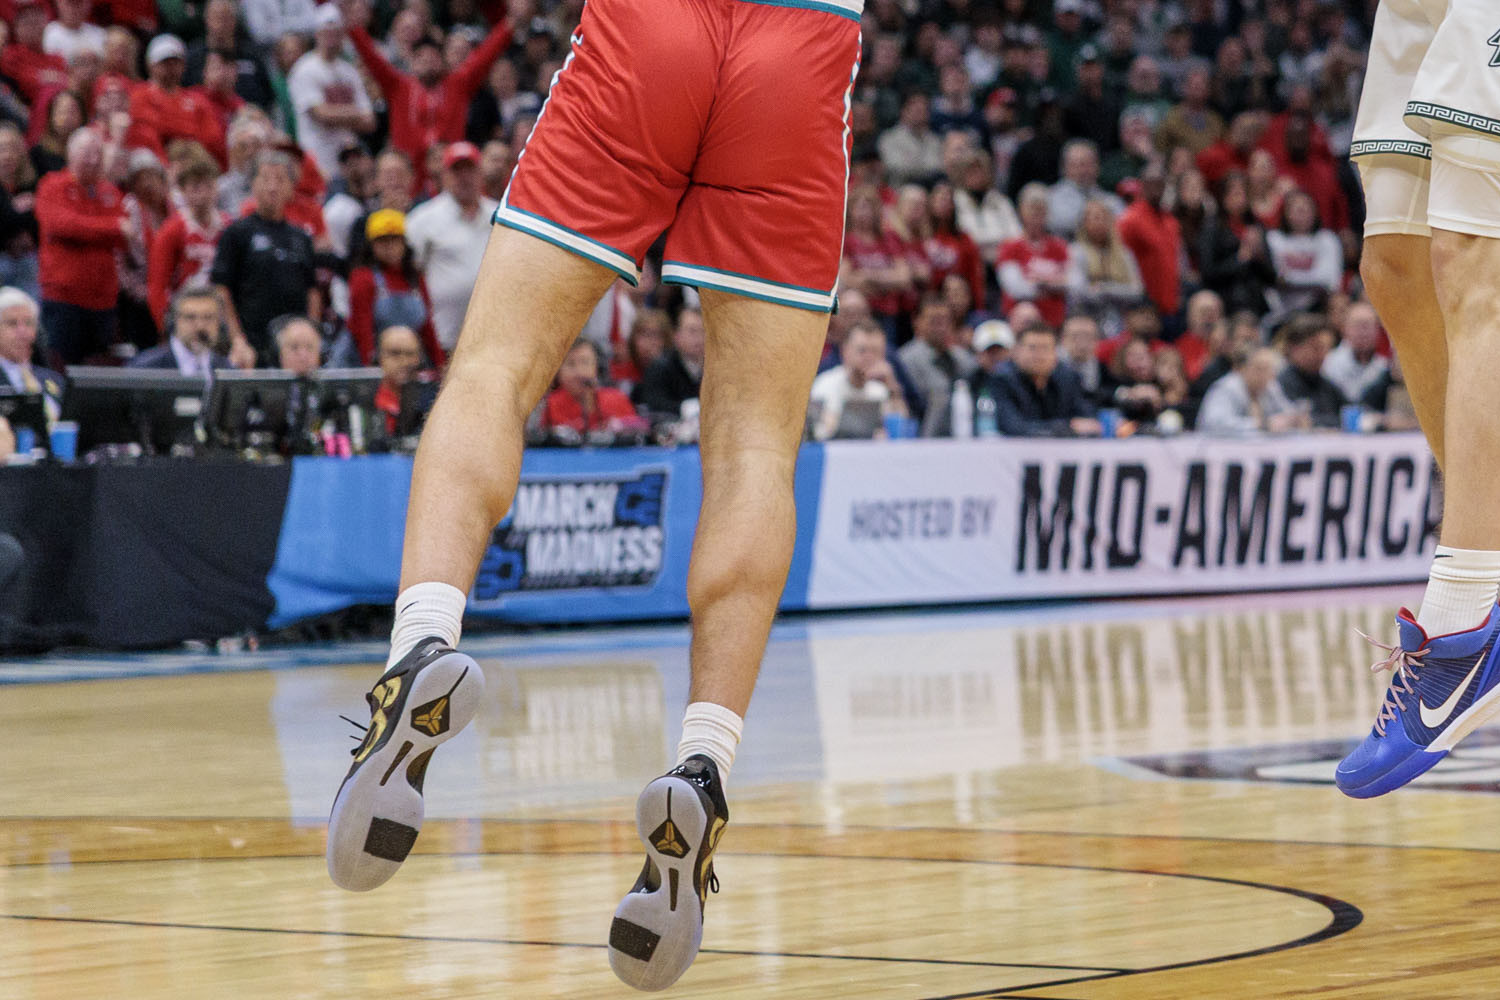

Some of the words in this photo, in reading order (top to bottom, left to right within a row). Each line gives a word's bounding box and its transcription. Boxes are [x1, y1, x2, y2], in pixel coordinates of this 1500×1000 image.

[514, 482, 620, 529] MARCH
[849, 499, 953, 540] HOSTED
[959, 497, 993, 538] BY
[1016, 455, 1443, 574] MID-AMERICA
[526, 525, 664, 576] MADNESS
